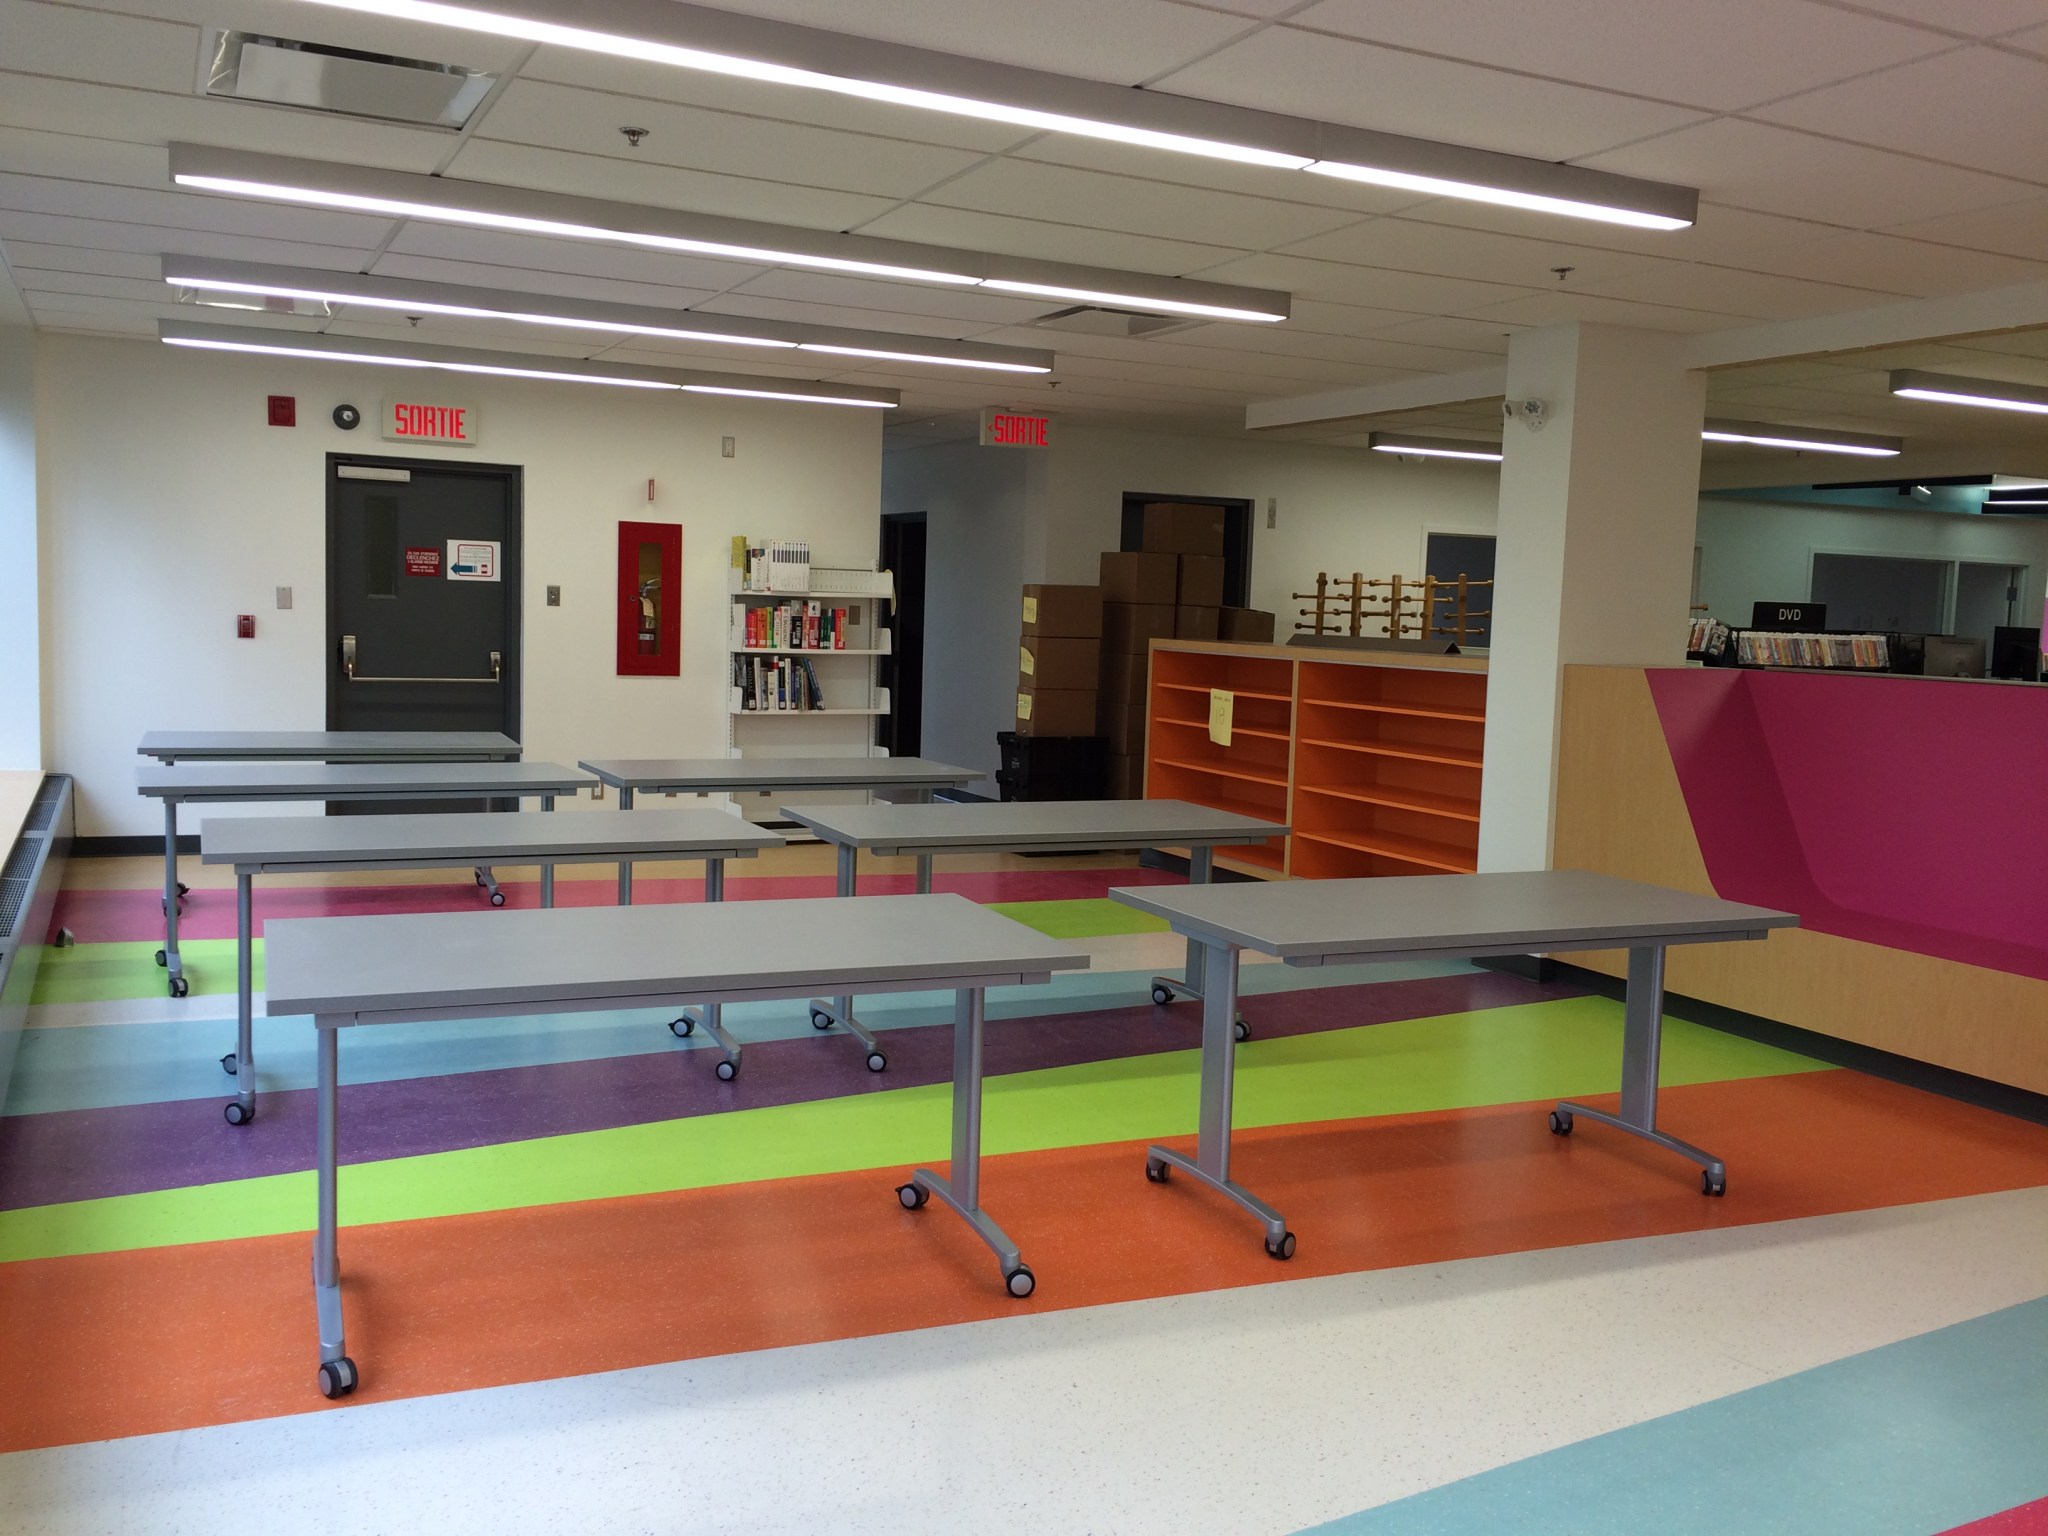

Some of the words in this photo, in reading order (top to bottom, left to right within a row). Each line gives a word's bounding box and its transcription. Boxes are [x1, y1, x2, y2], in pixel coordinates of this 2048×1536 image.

[395, 404, 466, 439] SORTIE
[994, 414, 1049, 446] SORTIE
[1779, 608, 1801, 621] DVD
